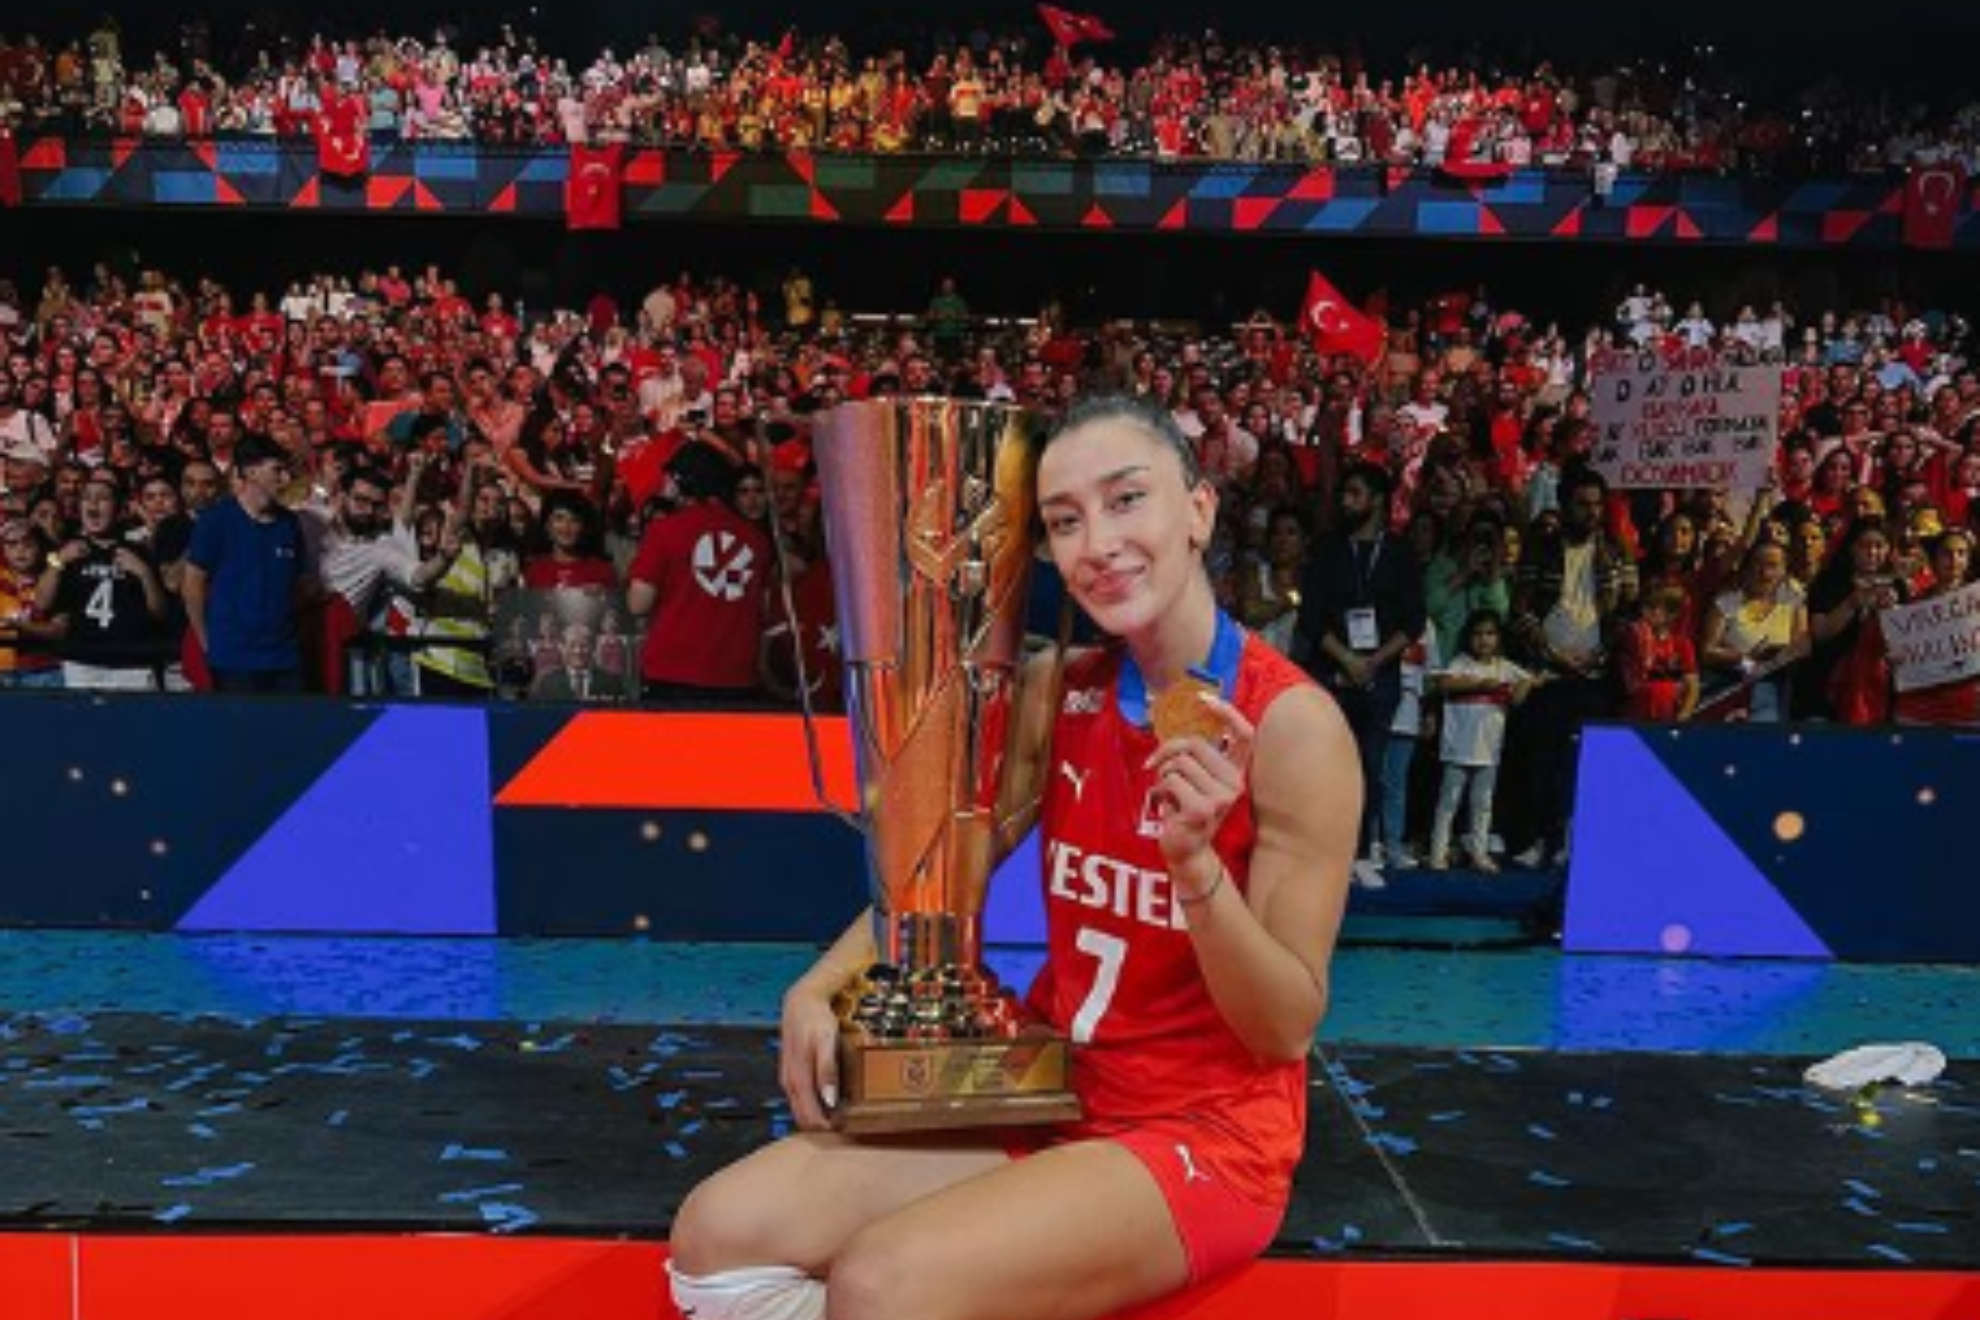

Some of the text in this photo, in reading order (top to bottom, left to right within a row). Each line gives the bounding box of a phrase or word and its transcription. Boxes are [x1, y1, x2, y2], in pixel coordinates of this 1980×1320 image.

[86, 578, 114, 628] 4
[1048, 838, 1190, 931] ESTE
[1070, 925, 1129, 1043] 7
